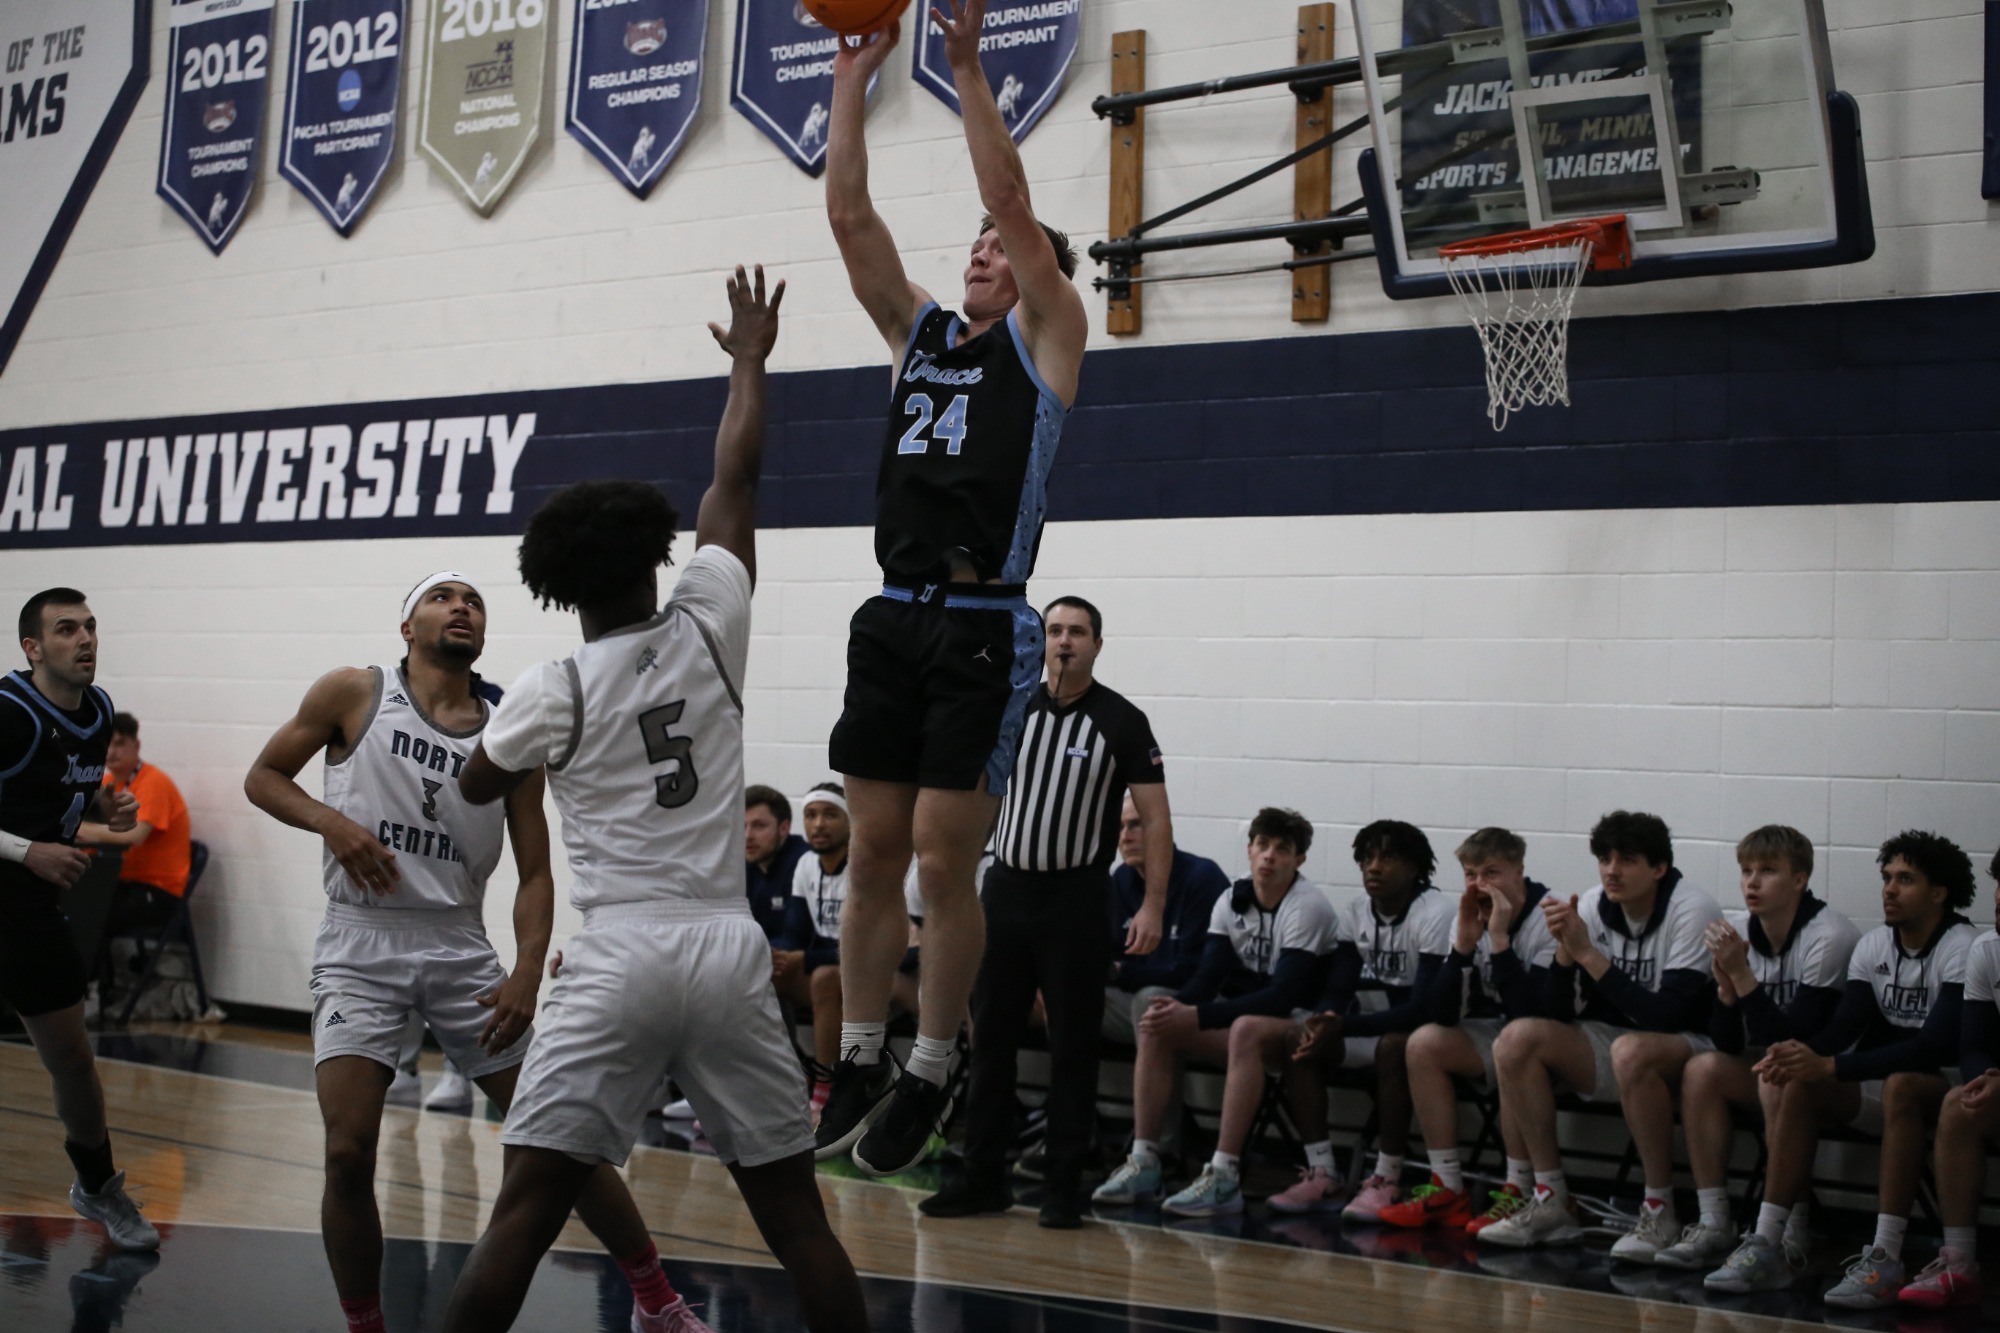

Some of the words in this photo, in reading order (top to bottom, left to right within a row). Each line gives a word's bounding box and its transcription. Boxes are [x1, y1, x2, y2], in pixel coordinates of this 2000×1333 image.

[982, 0, 1080, 29] TOURNAMENT
[6, 37, 34, 73] OF
[43, 25, 86, 66] THE
[305, 11, 398, 73] 2012
[978, 25, 1059, 52] RTICIPANT
[181, 33, 268, 93] 2012
[588, 68, 648, 90] REGULAR
[649, 60, 699, 81] SEASON
[776, 60, 836, 82] CHAMPIO
[0, 72, 69, 143] MS
[460, 94, 517, 114] NATIONAL
[607, 84, 681, 108] CHAMPIONS
[1433, 79, 1513, 115] JACK
[454, 112, 521, 135] CHAMPIONS
[187, 137, 254, 160] TOURNAMENT
[314, 133, 382, 156] PARTICIPANT
[191, 156, 249, 178] CHAMPIONS
[1415, 162, 1508, 190] SPORTS
[897, 393, 969, 456] 24
[100, 413, 537, 528] UNIVERSITY
[391, 729, 467, 779] NORT
[638, 699, 698, 809] 5
[60, 791, 85, 839] 4
[422, 777, 443, 822] 3
[378, 819, 461, 863] CENTR
